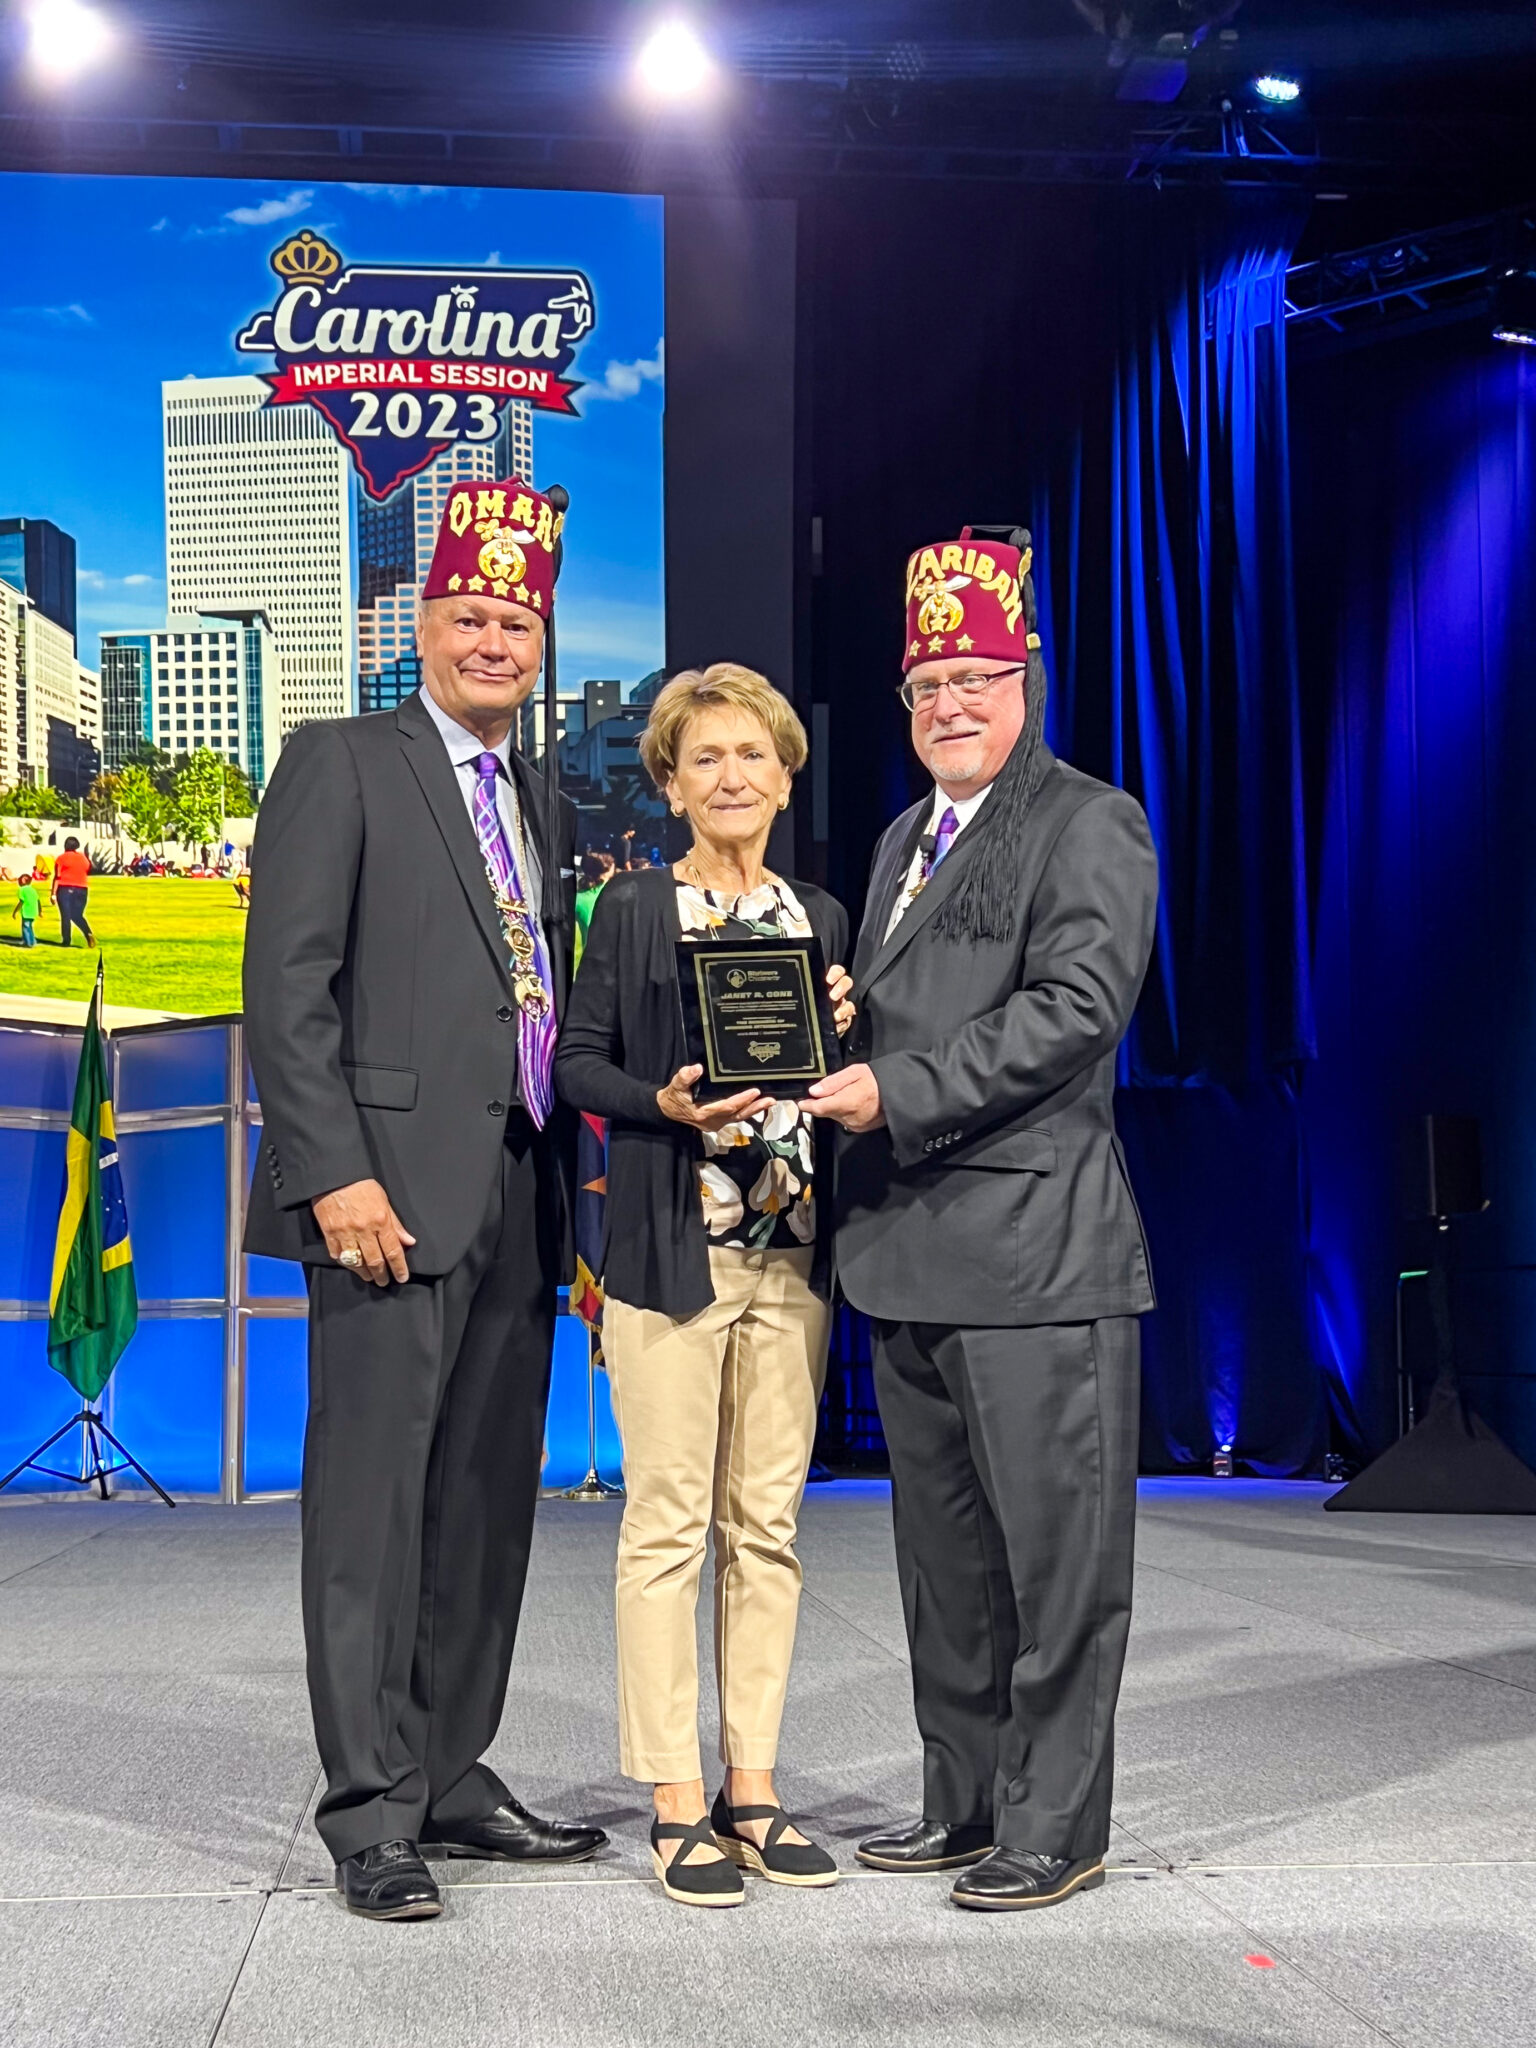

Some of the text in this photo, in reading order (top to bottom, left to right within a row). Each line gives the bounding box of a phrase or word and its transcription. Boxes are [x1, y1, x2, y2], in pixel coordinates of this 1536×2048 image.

[274, 285, 562, 358] Carolina
[293, 362, 548, 392] IMPERIAL SESSION
[348, 391, 498, 439] 2023
[449, 489, 553, 553] OMAR
